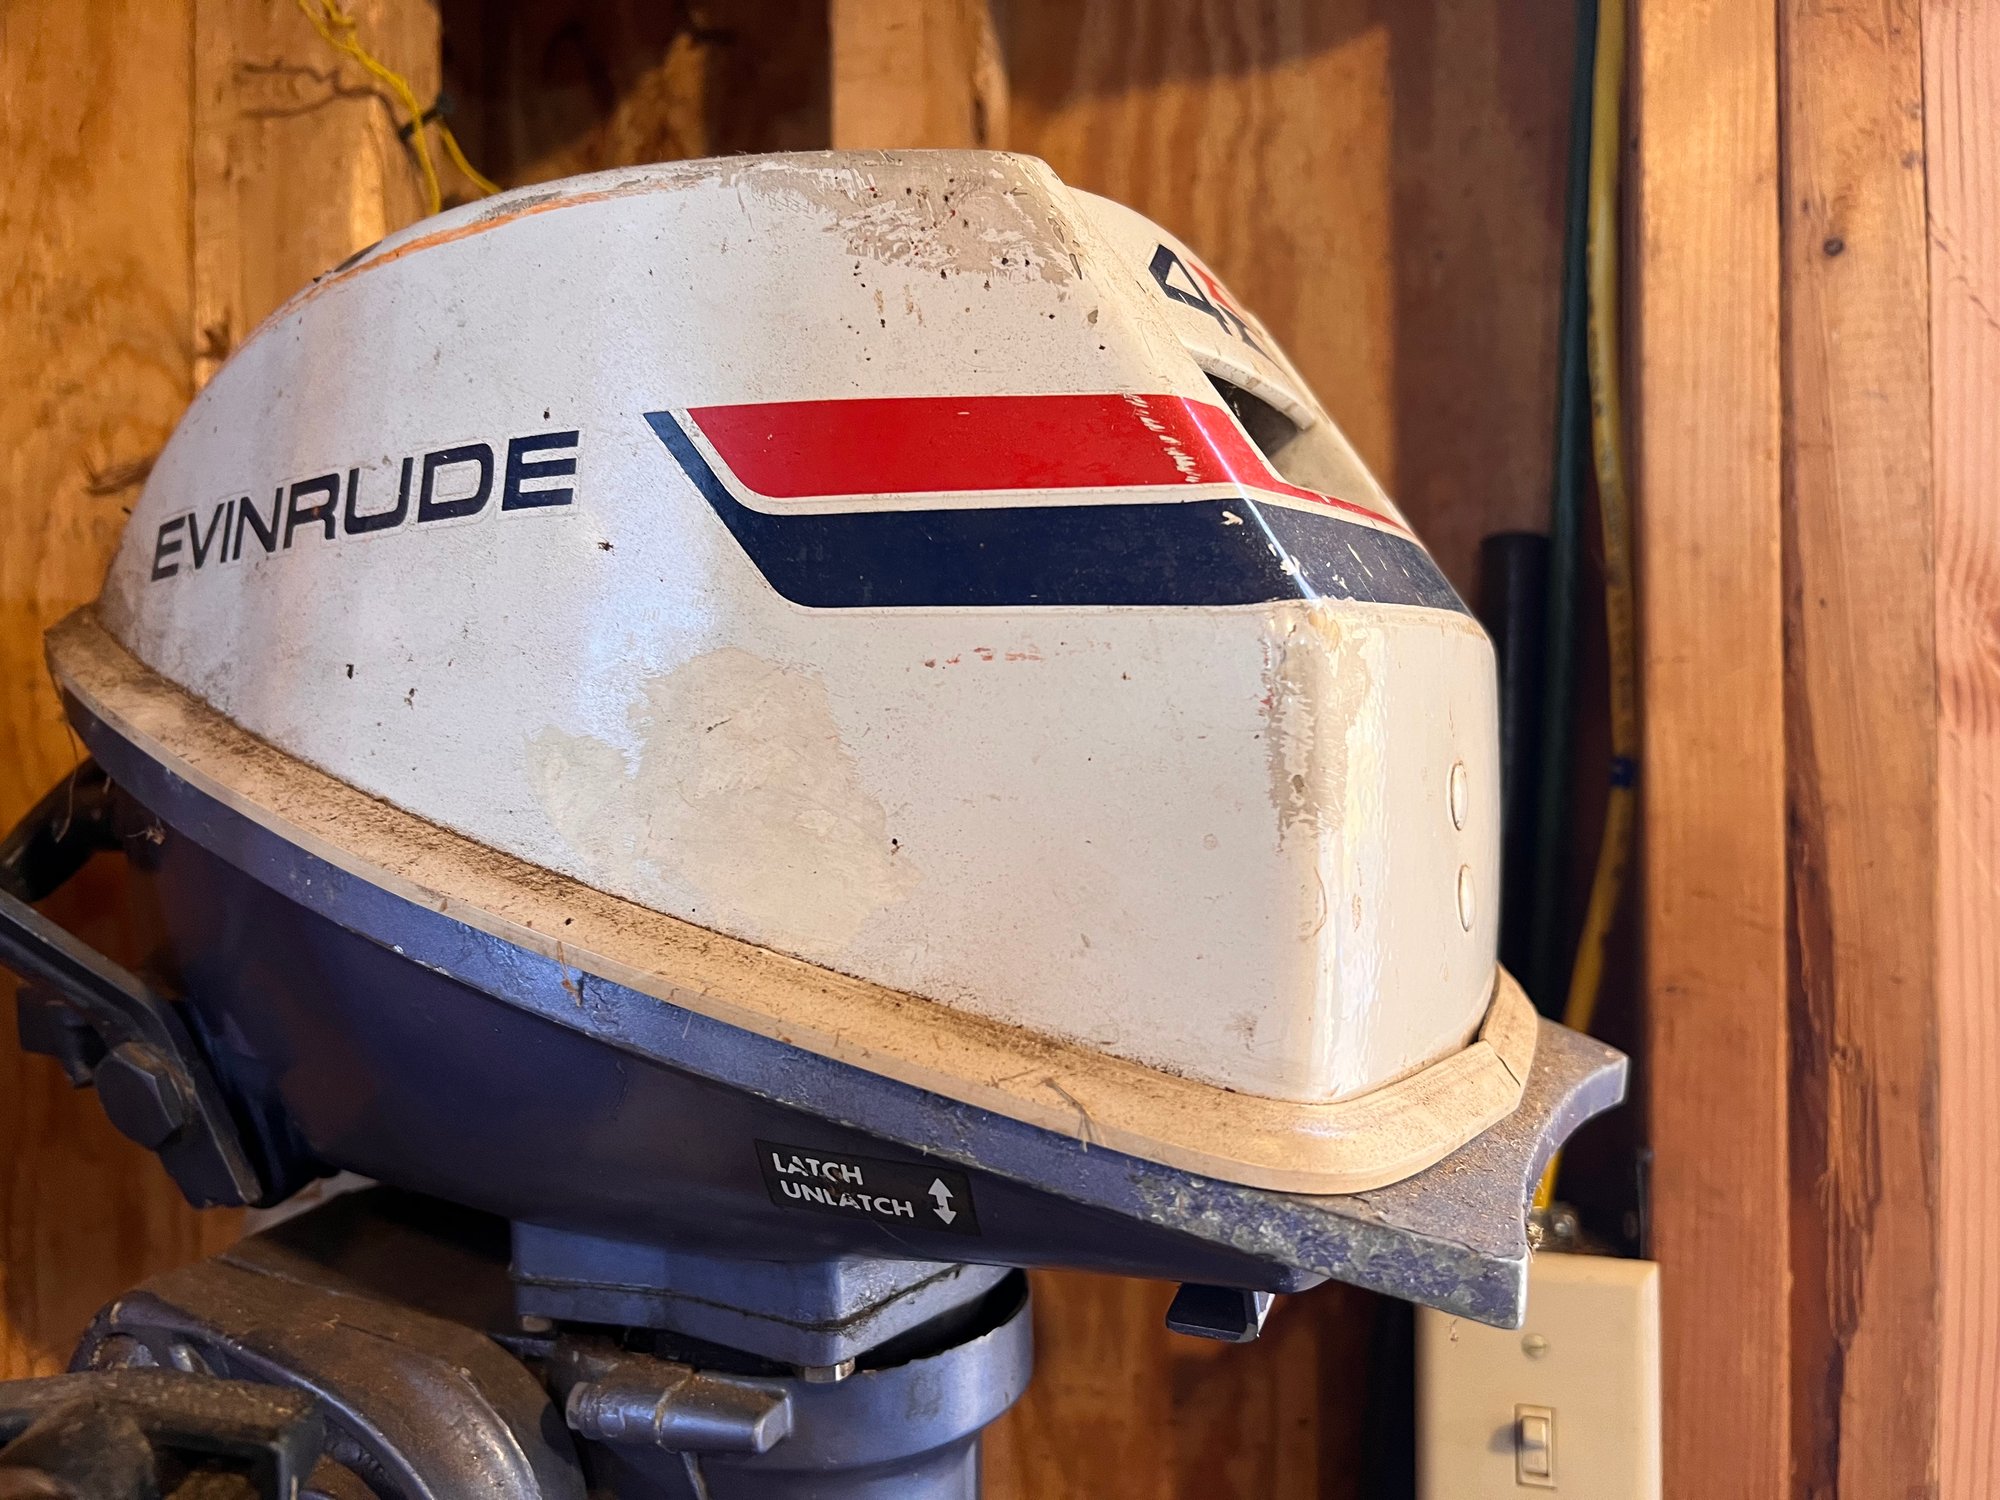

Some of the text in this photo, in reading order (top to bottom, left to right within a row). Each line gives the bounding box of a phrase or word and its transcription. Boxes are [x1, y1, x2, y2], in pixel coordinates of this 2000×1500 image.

[151, 430, 579, 582] EVINRUDE
[772, 1153, 864, 1185] LATCH
[780, 1180, 915, 1218] UNLATCH
